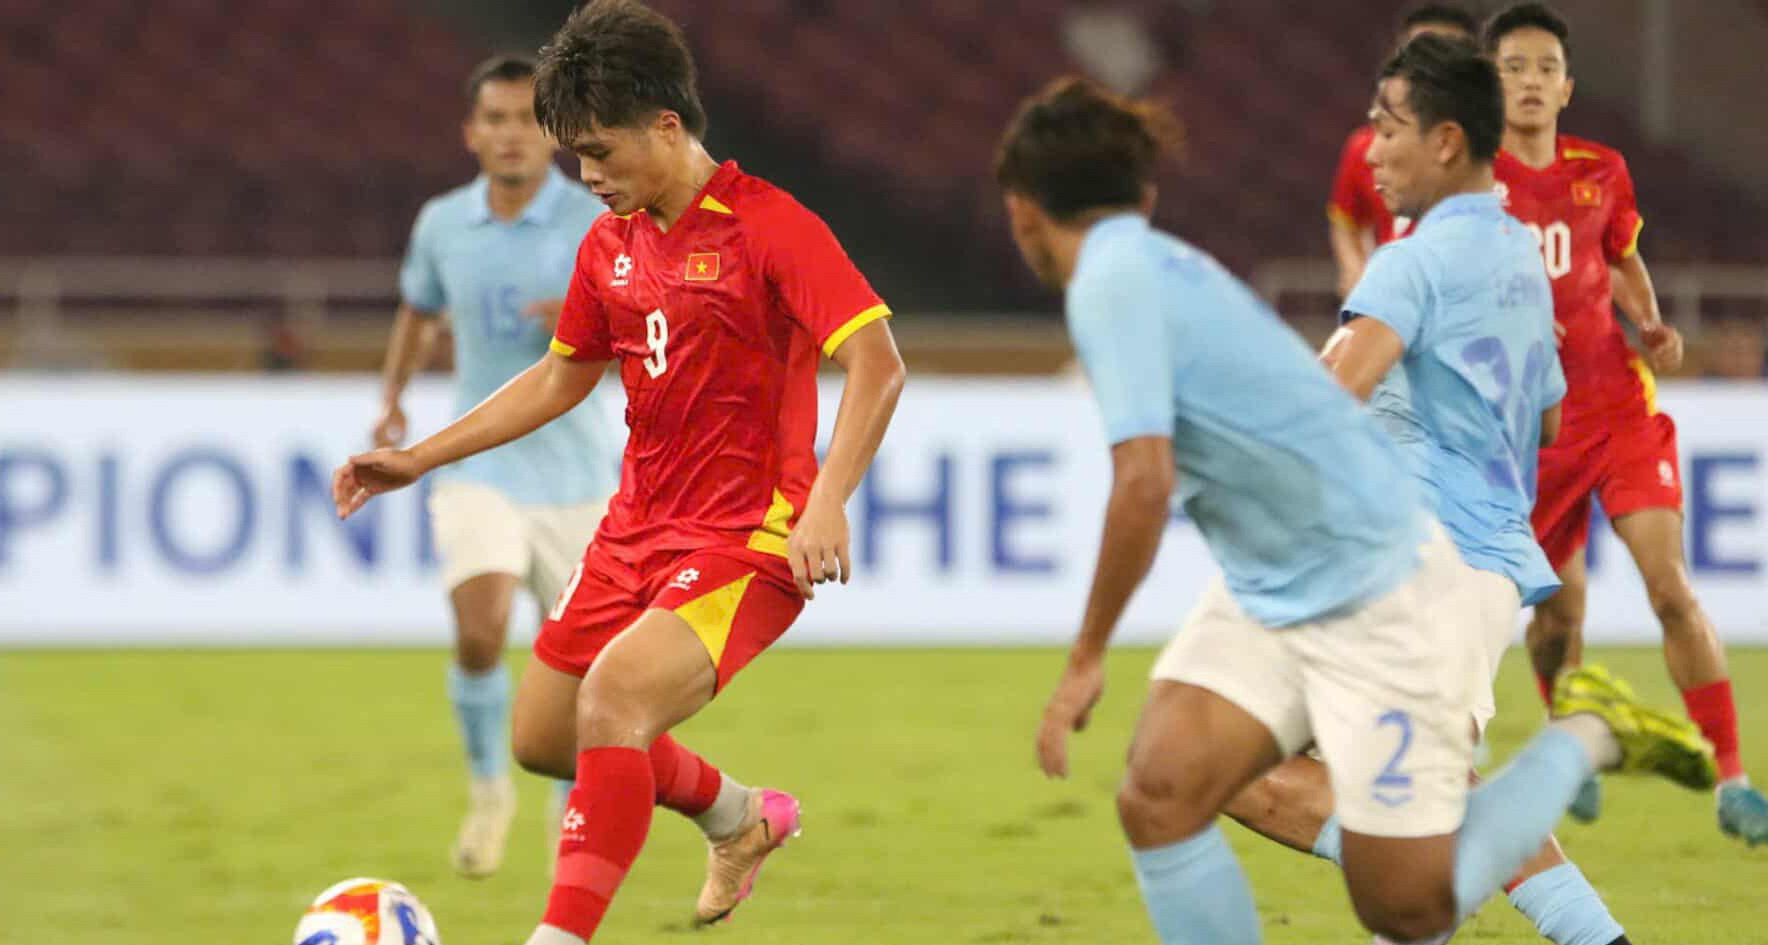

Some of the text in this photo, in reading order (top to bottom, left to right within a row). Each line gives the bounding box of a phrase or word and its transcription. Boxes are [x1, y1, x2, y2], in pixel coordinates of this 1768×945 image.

[643, 309, 669, 379] 9
[0, 450, 440, 573] PION
[816, 447, 1060, 573] HE
[1373, 709, 1414, 788] 2
